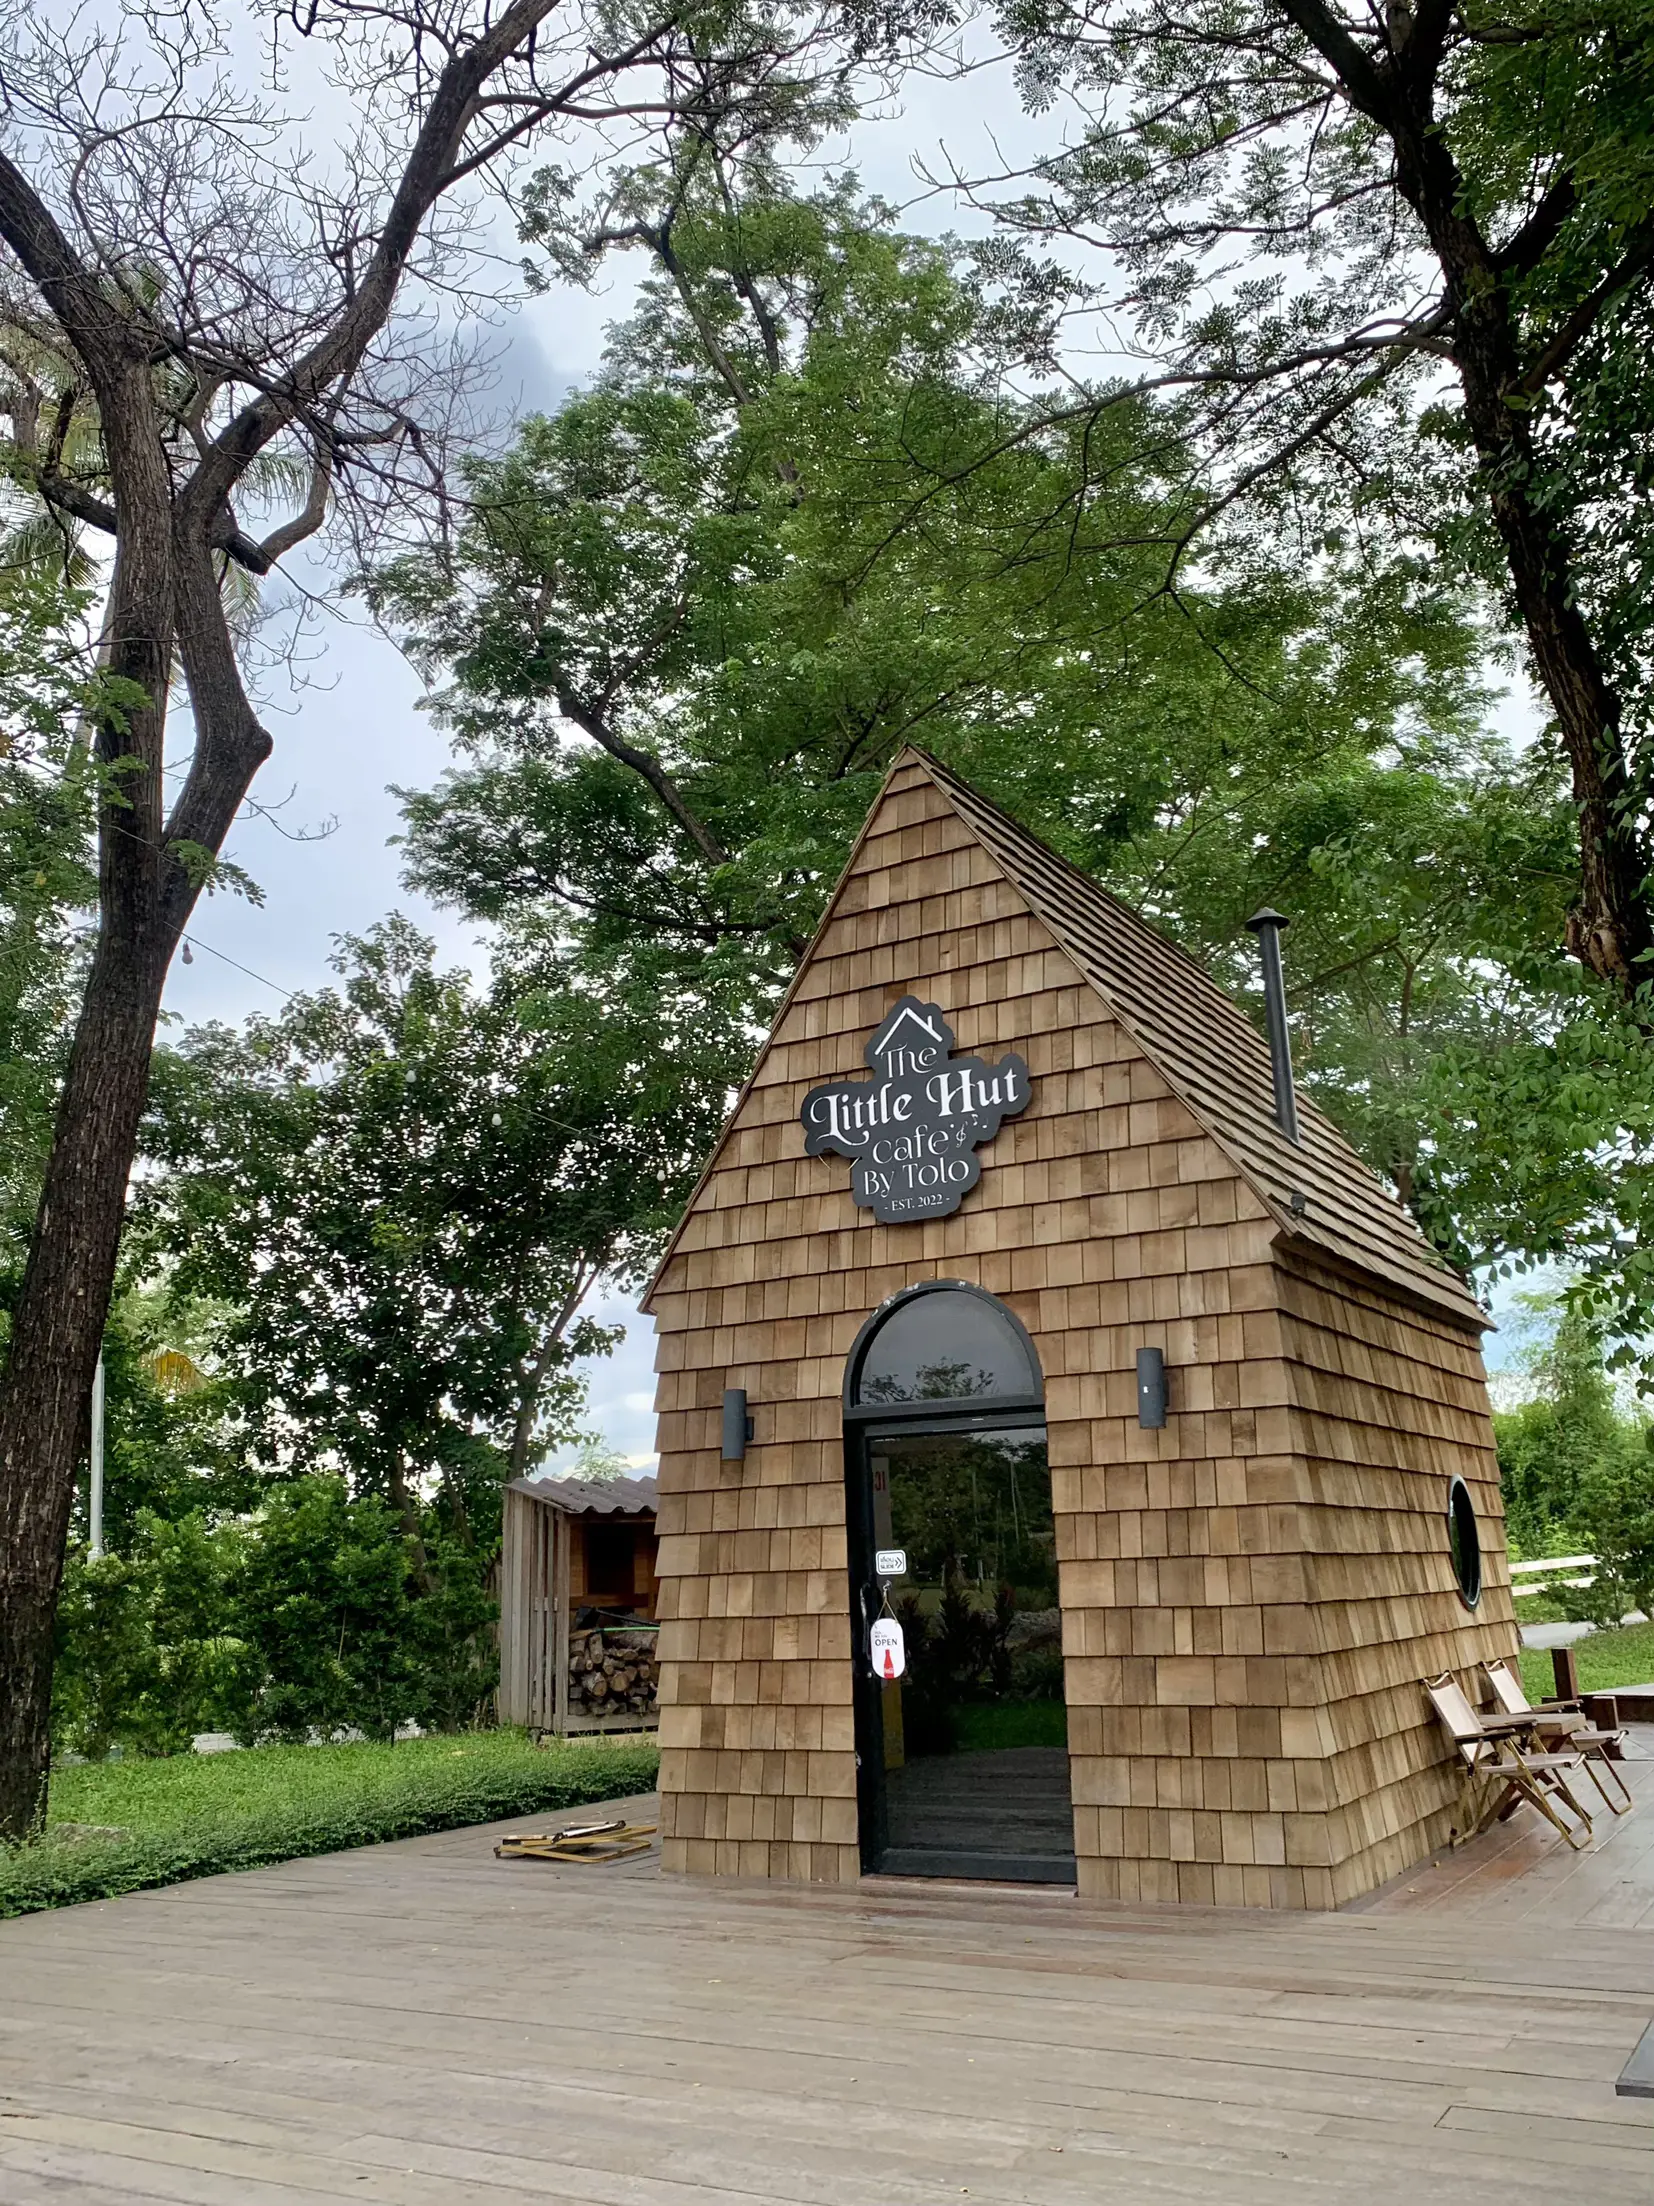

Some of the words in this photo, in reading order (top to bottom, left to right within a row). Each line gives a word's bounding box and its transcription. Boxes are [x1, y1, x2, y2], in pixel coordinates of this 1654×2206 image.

[880, 1043, 938, 1078] The
[810, 1082, 913, 1146] Little
[926, 1068, 1019, 1117] Hut
[864, 1170, 895, 1198] By
[902, 1157, 970, 1189] Tolo
[891, 1198, 915, 1211] EST.
[918, 1193, 943, 1207] 2022
[874, 1638, 898, 1646] OPEN
